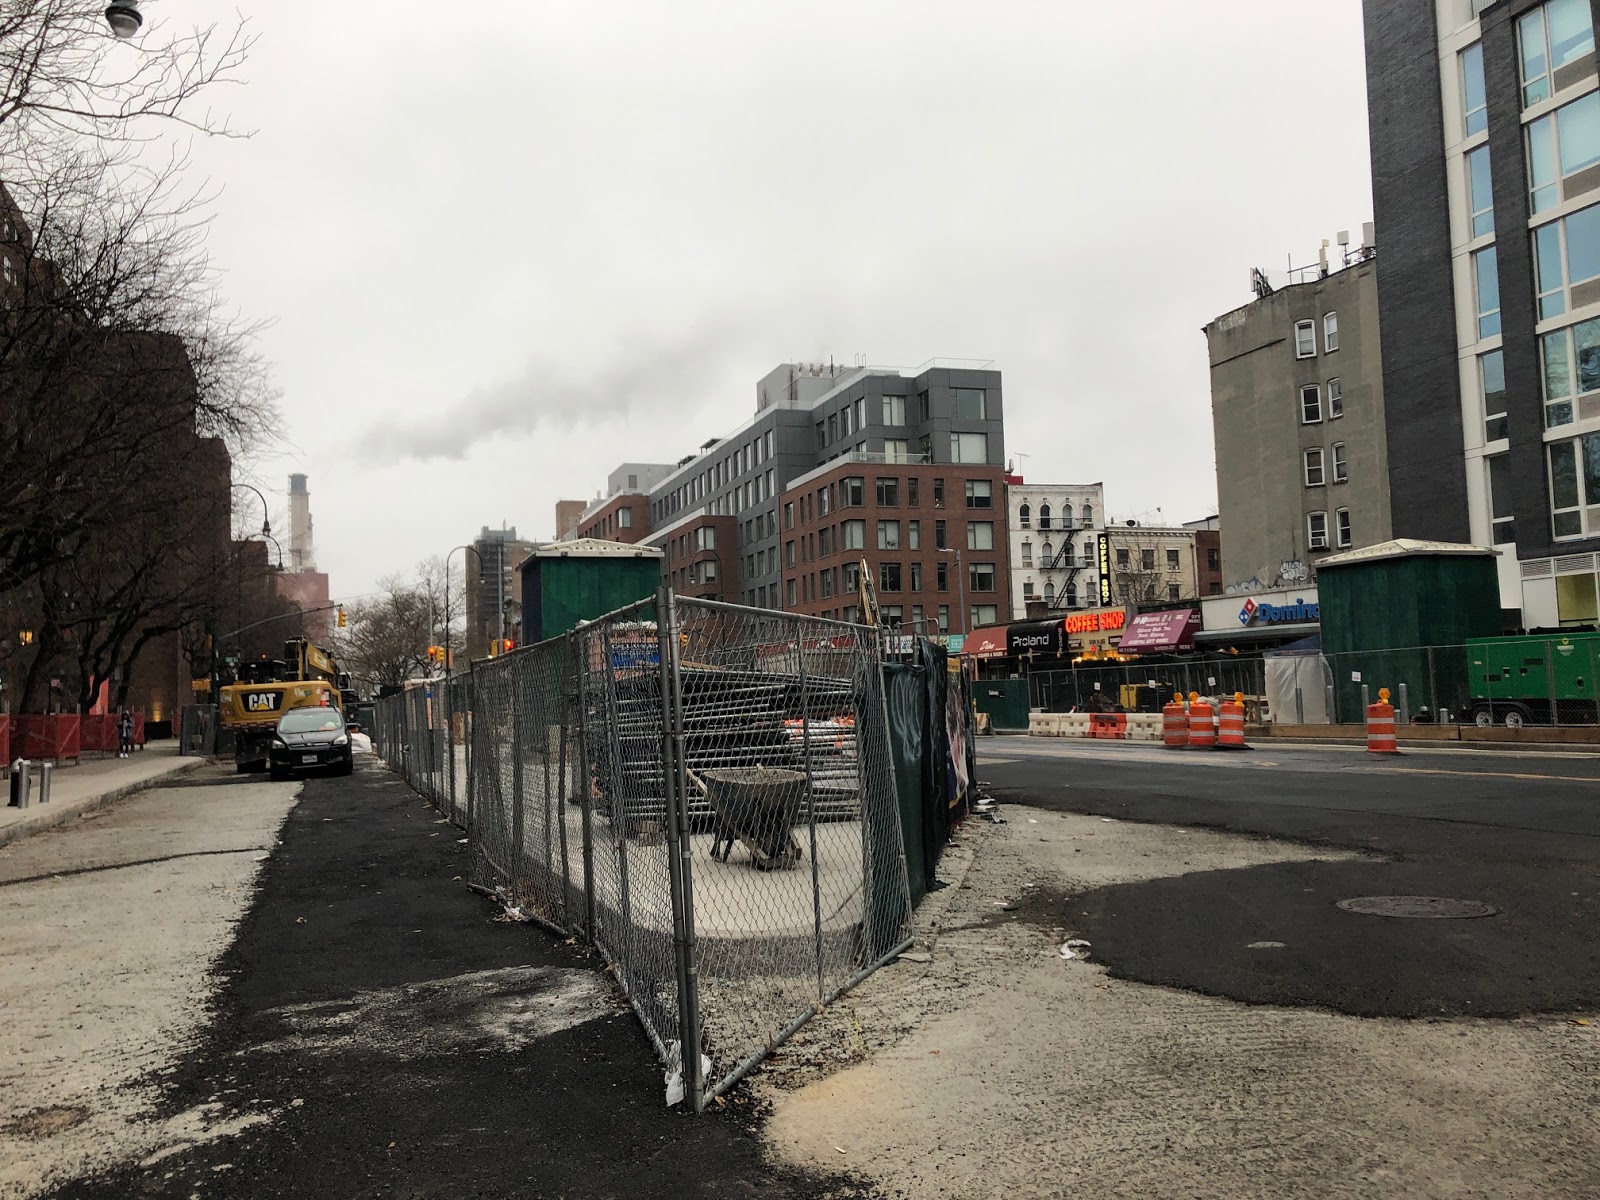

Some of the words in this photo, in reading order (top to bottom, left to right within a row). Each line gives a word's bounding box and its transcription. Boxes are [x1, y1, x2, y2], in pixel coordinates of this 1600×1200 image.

[1100, 537, 1108, 574] COFFEE
[1101, 579, 1109, 603] SHOP
[1065, 614, 1099, 633] COFFEE
[1100, 611, 1125, 630] SHOP
[1012, 634, 1049, 647] Proland
[248, 693, 276, 711] CAT
